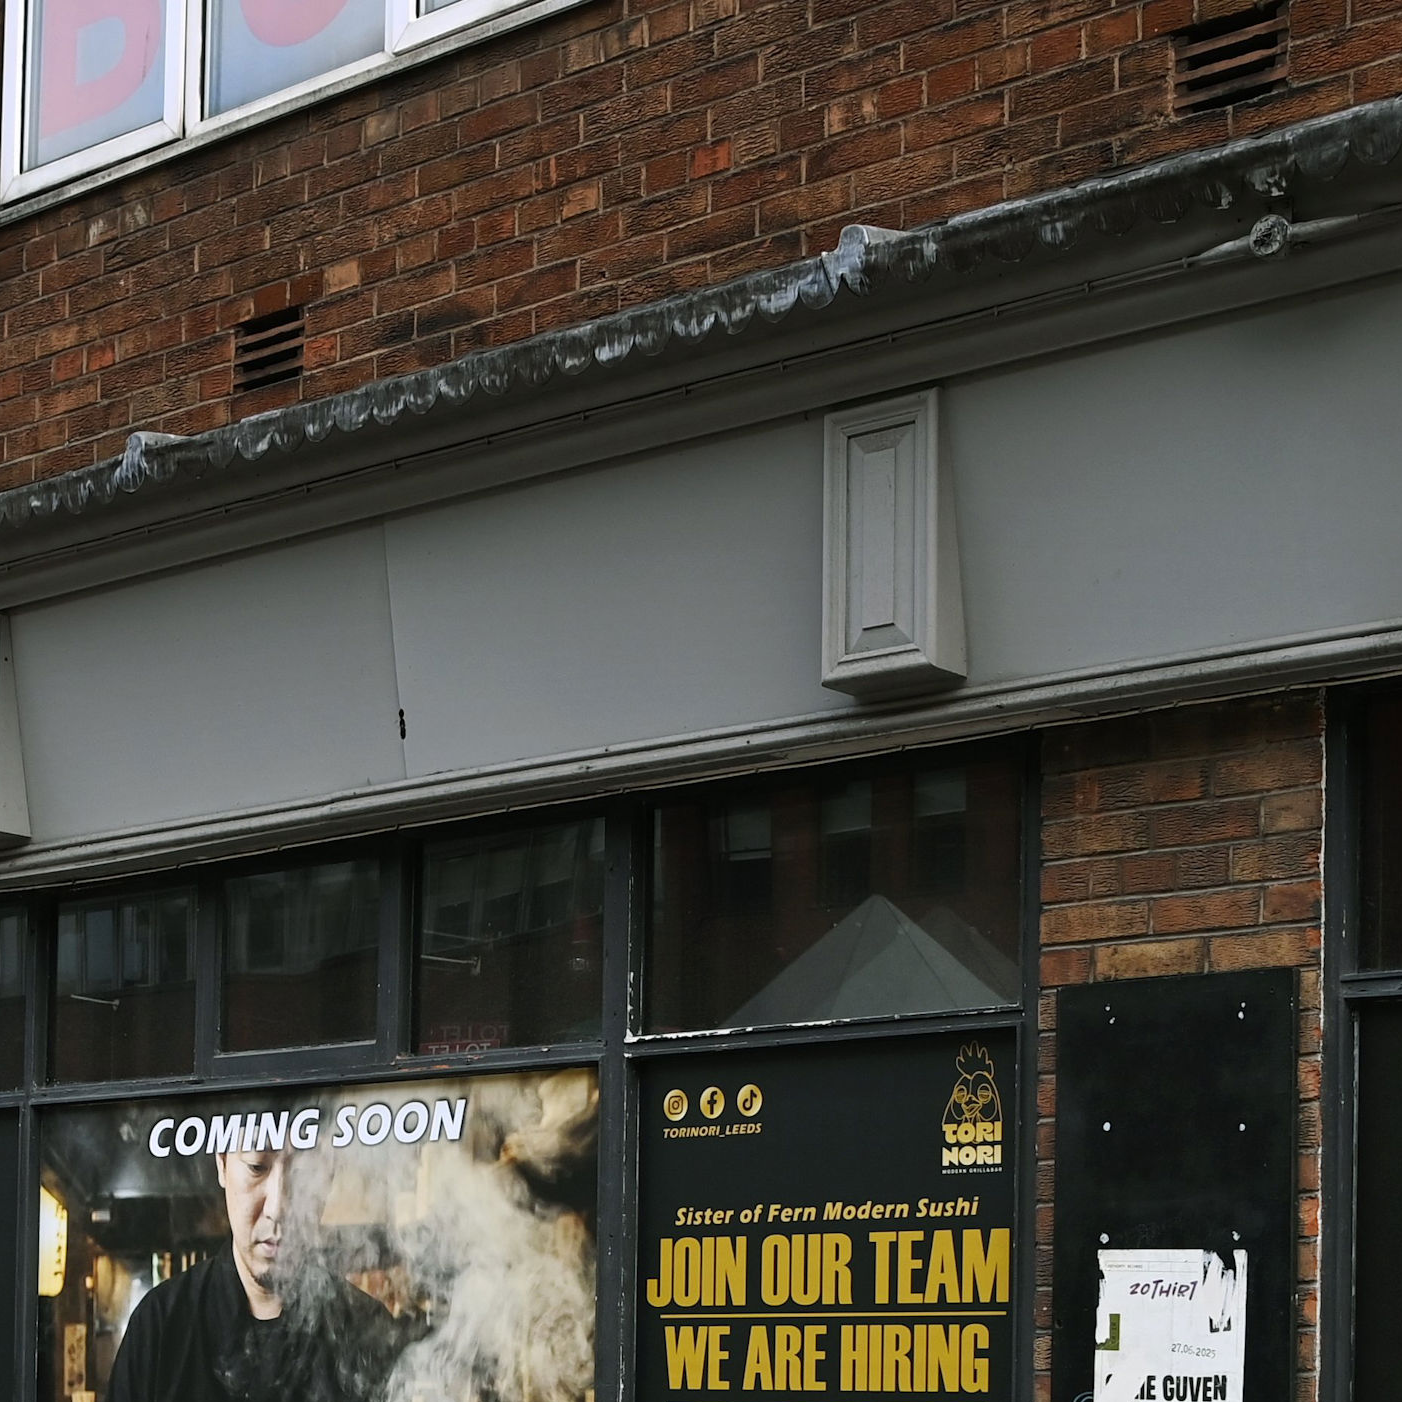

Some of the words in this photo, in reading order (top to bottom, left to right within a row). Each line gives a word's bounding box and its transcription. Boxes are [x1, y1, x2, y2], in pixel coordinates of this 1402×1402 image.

[149, 1107, 321, 1158] COMING
[332, 1098, 467, 1148] SOON
[662, 1122, 762, 1140] TORINORI_LEEDS
[942, 1121, 1003, 1144] TORI
[942, 1145, 1002, 1166] NORI
[675, 1206, 734, 1226] Sister
[740, 1204, 763, 1223] of
[767, 1203, 816, 1222] Fern
[823, 1200, 908, 1221] Modern
[915, 1196, 980, 1218] Sushi
[646, 1236, 747, 1308] JOIN
[760, 1232, 853, 1306] OUR
[869, 1228, 1011, 1305] TEAM
[664, 1325, 731, 1391] WE
[742, 1325, 827, 1392] ARE
[839, 1323, 990, 1394] HIRING
[1162, 1375, 1227, 1402] GUVEN
